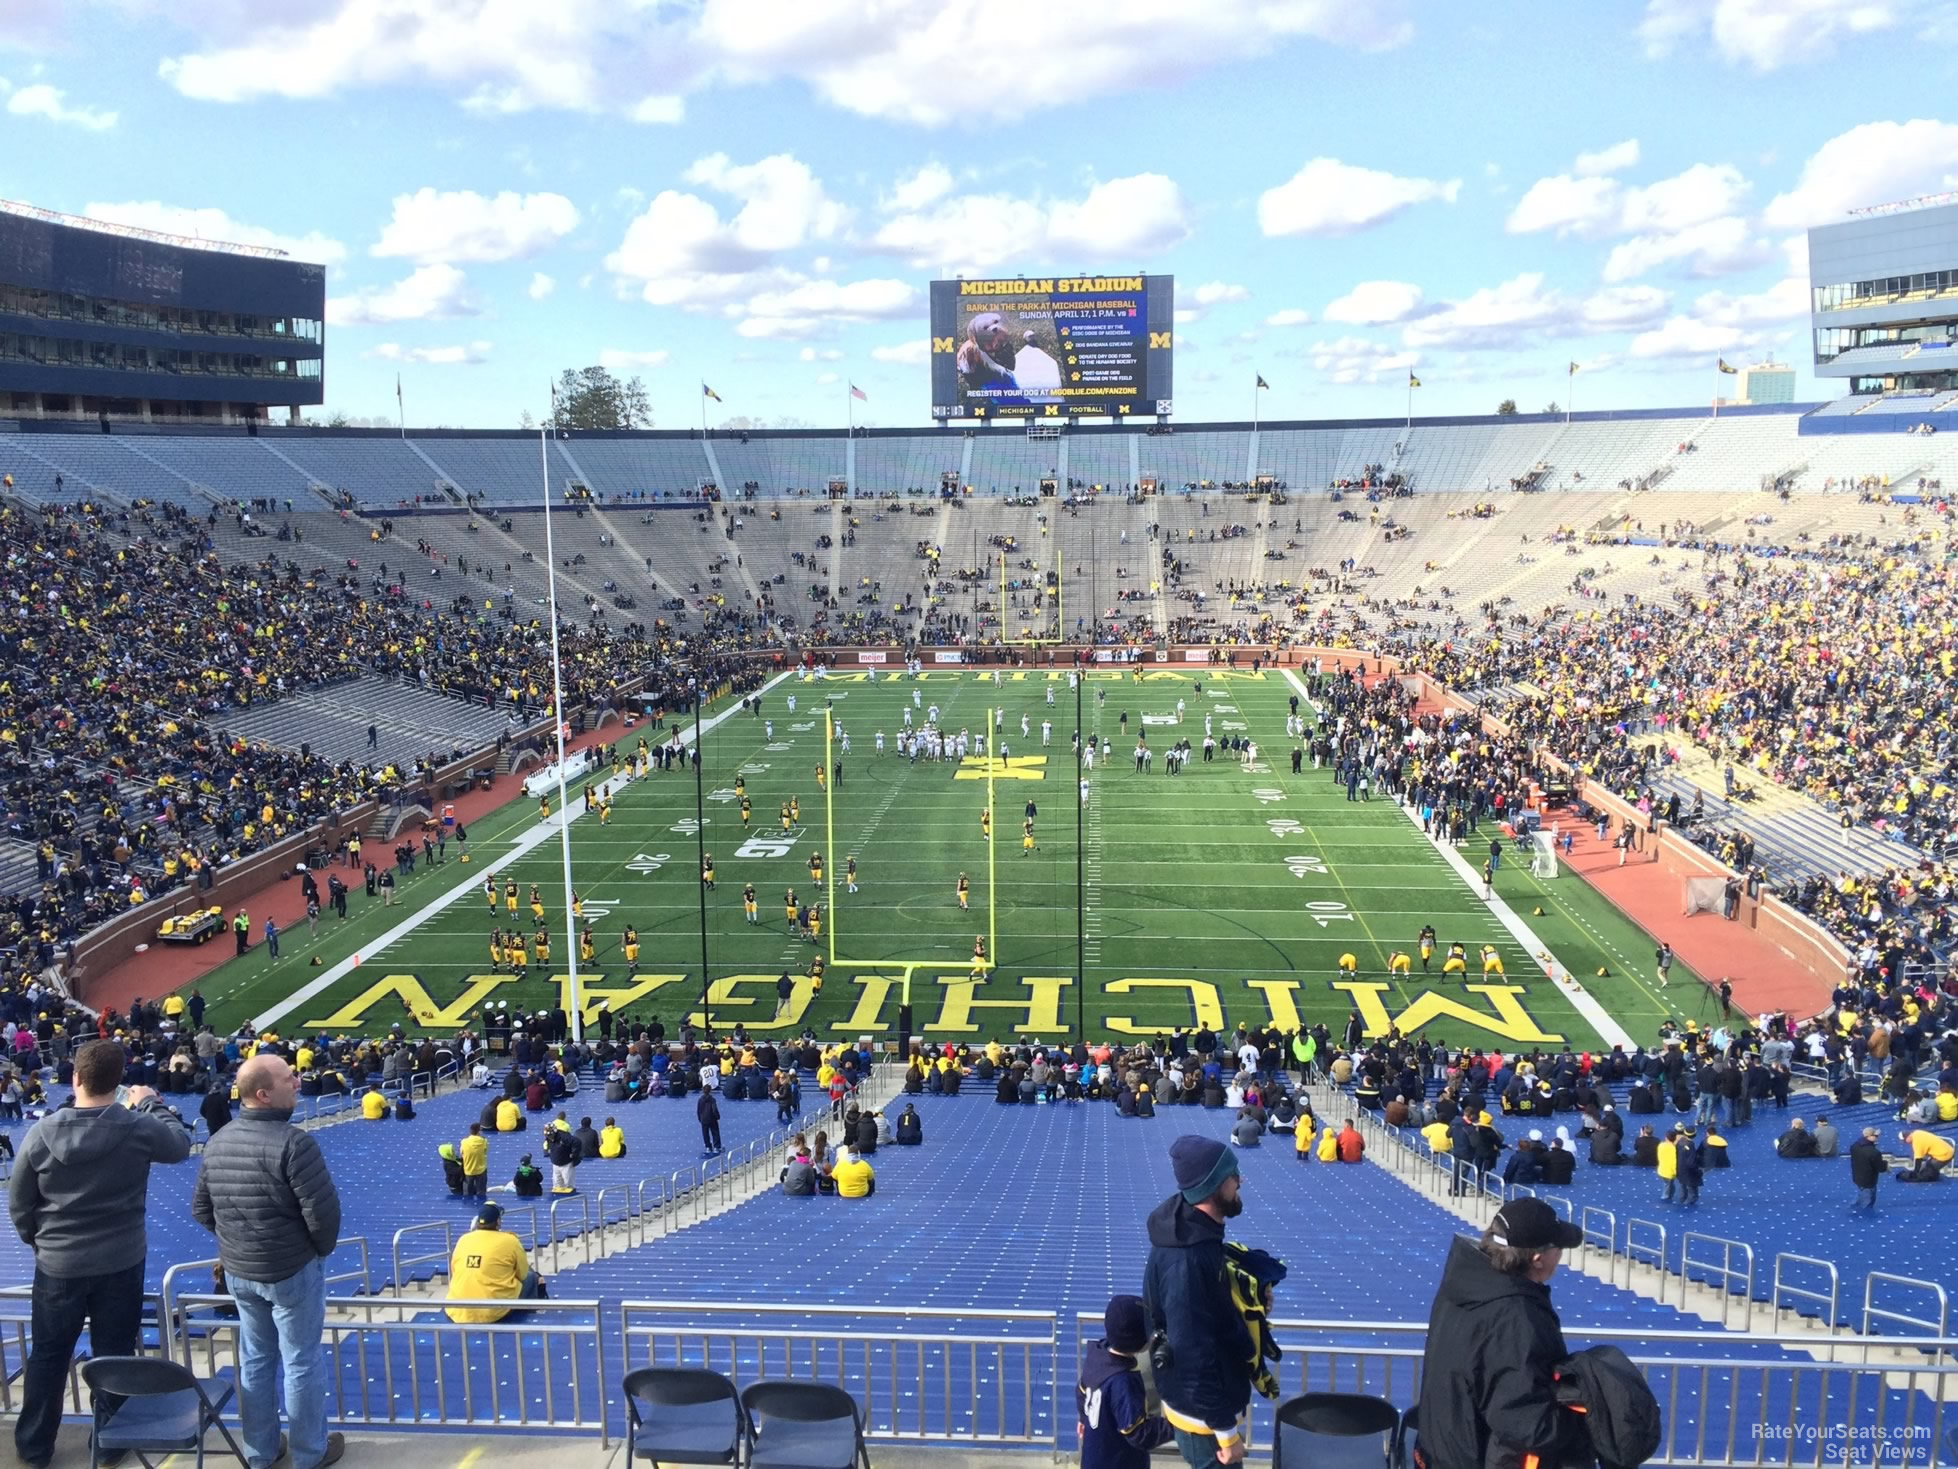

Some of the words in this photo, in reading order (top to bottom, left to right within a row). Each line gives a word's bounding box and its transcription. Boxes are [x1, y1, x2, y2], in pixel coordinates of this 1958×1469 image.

[961, 280, 1054, 295] MICHIGAN
[1058, 277, 1143, 292] STADIUM
[966, 303, 988, 312] BARK
[990, 303, 999, 311] IN
[1000, 303, 1016, 311] THE
[1018, 302, 1039, 310] PARK
[1041, 302, 1051, 310] AT
[1052, 301, 1095, 310] MICHIGAN
[1096, 300, 1137, 309] BASEBALL
[1019, 311, 1053, 320] SUNDAY,
[1054, 310, 1079, 318] APRIL
[1092, 310, 1097, 318] 1
[1098, 309, 1115, 317] P.M.
[933, 336, 954, 353] M
[1149, 332, 1171, 348] M
[966, 389, 1002, 398] REGISTER
[1003, 389, 1023, 397] YOUR
[1050, 387, 1137, 396] MGOBLUE.COM/FANZONE
[974, 407, 985, 416] M
[1045, 405, 1058, 416] M
[1119, 404, 1130, 414] M
[860, 653, 885, 663] meijer
[625, 853, 671, 871] 20
[1283, 856, 1328, 873] 20
[1305, 901, 1354, 921] 10
[302, 974, 1566, 1042] MICHIGAN
[702, 1067, 714, 1078] 20
[467, 1256, 480, 1267] M
